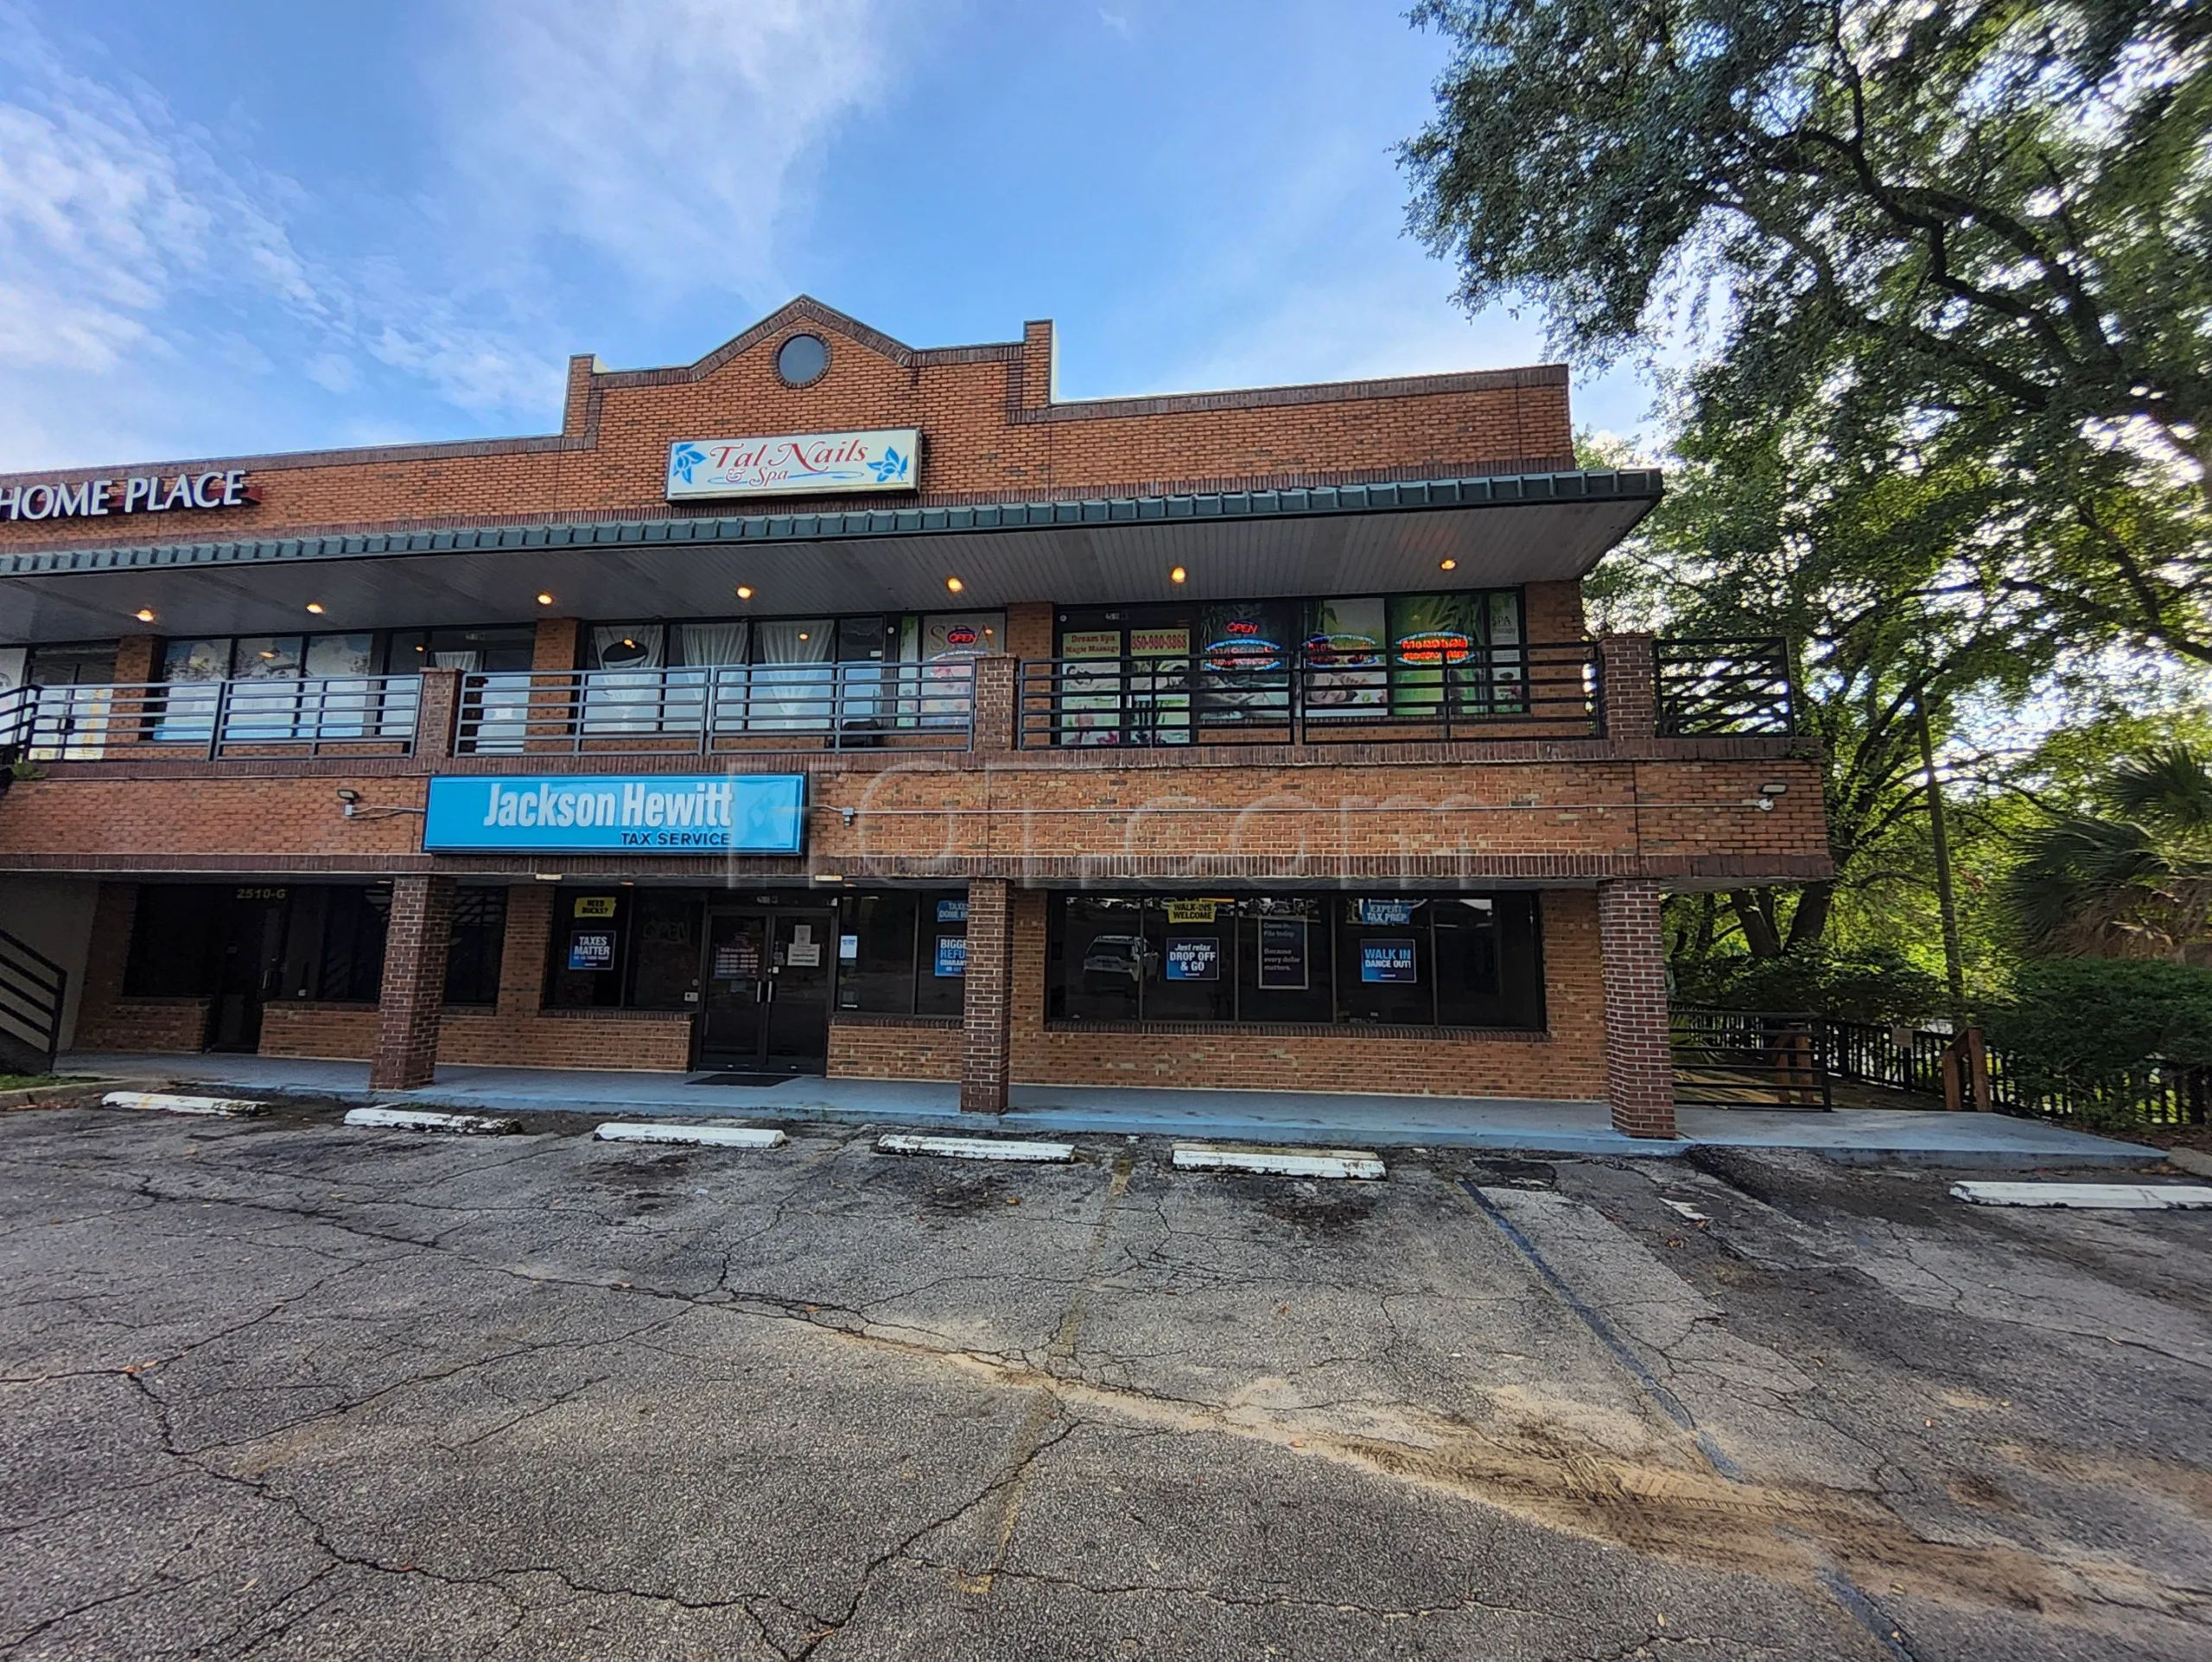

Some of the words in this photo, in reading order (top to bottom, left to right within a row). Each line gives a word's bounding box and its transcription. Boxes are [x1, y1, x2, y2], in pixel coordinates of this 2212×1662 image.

[709, 443, 767, 468] Tal
[768, 438, 869, 474] Nails
[748, 466, 788, 487] Spa
[0, 479, 113, 520] HOME
[124, 469, 246, 513] PLACE
[1227, 621, 1258, 634] OPEN
[949, 633, 976, 643] OPEN
[483, 782, 616, 828] Jackson
[620, 782, 733, 827] Hewitt
[620, 831, 652, 846] TAX
[657, 831, 731, 846] SERVICE
[236, 888, 286, 900] 2510-G
[1173, 911, 1212, 920] WELCOME
[1366, 913, 1383, 921] TAX
[578, 936, 607, 946] TAXES
[940, 939, 968, 949] BIGGE
[574, 945, 611, 956] MATTER
[940, 949, 966, 958] REFU
[1363, 948, 1396, 959] WALK
[1399, 948, 1412, 959] IN
[1169, 952, 1196, 961] DROP
[1198, 952, 1217, 961] OFF
[1180, 961, 1189, 971] &
[1191, 961, 1205, 971] GO
[1364, 959, 1391, 969] DANCE
